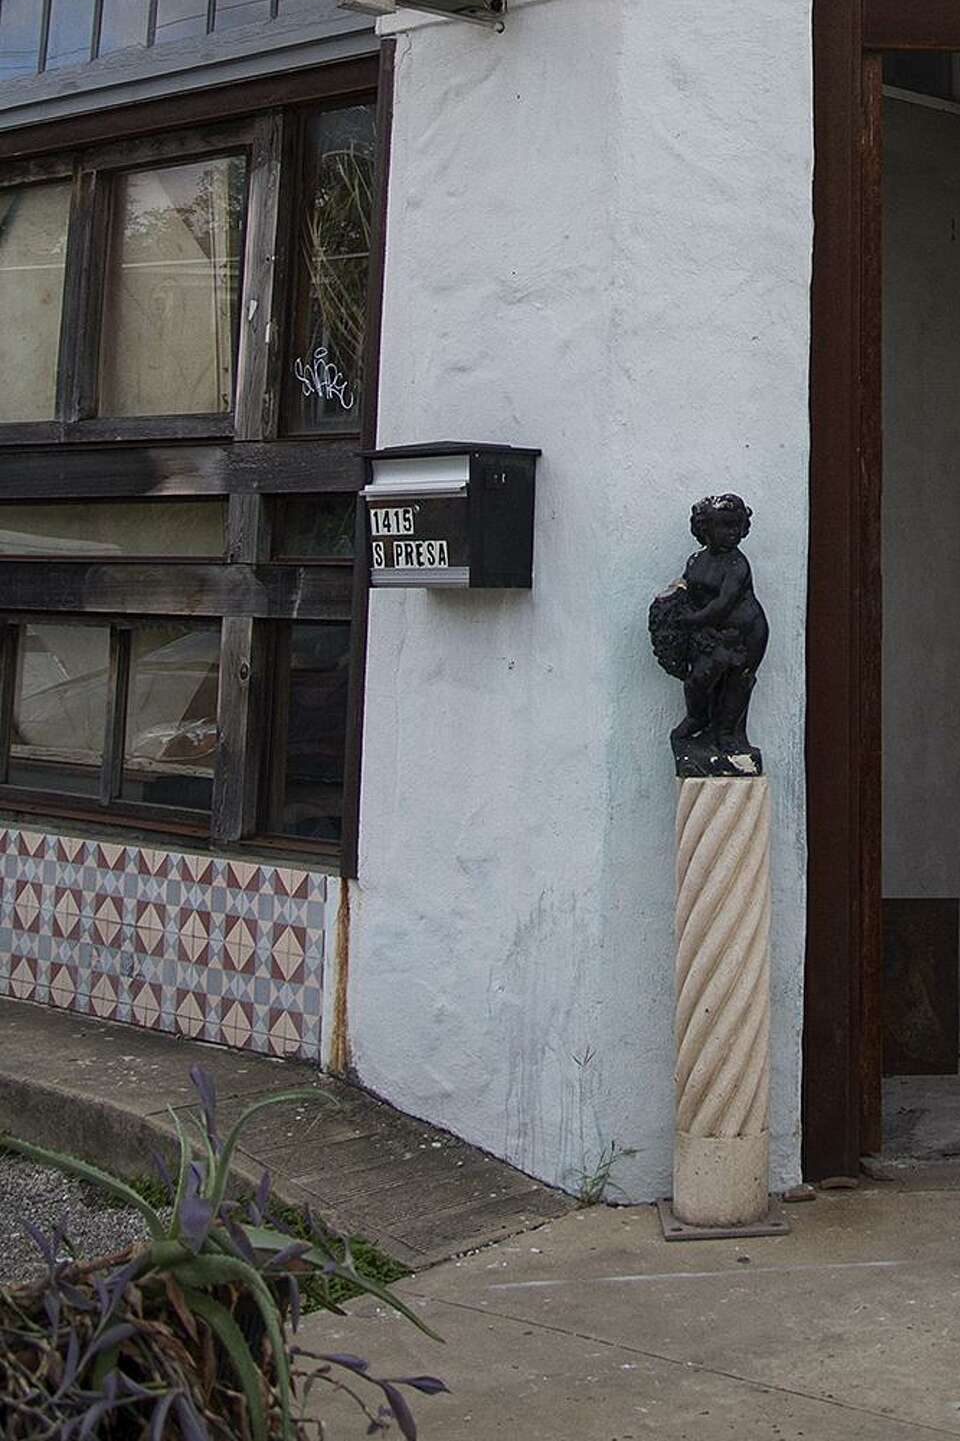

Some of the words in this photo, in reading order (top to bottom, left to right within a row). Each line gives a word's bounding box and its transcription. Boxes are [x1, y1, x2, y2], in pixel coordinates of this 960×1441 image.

[372, 509, 413, 534] 1415
[374, 543, 383, 567] S
[395, 541, 447, 567] PRESA
